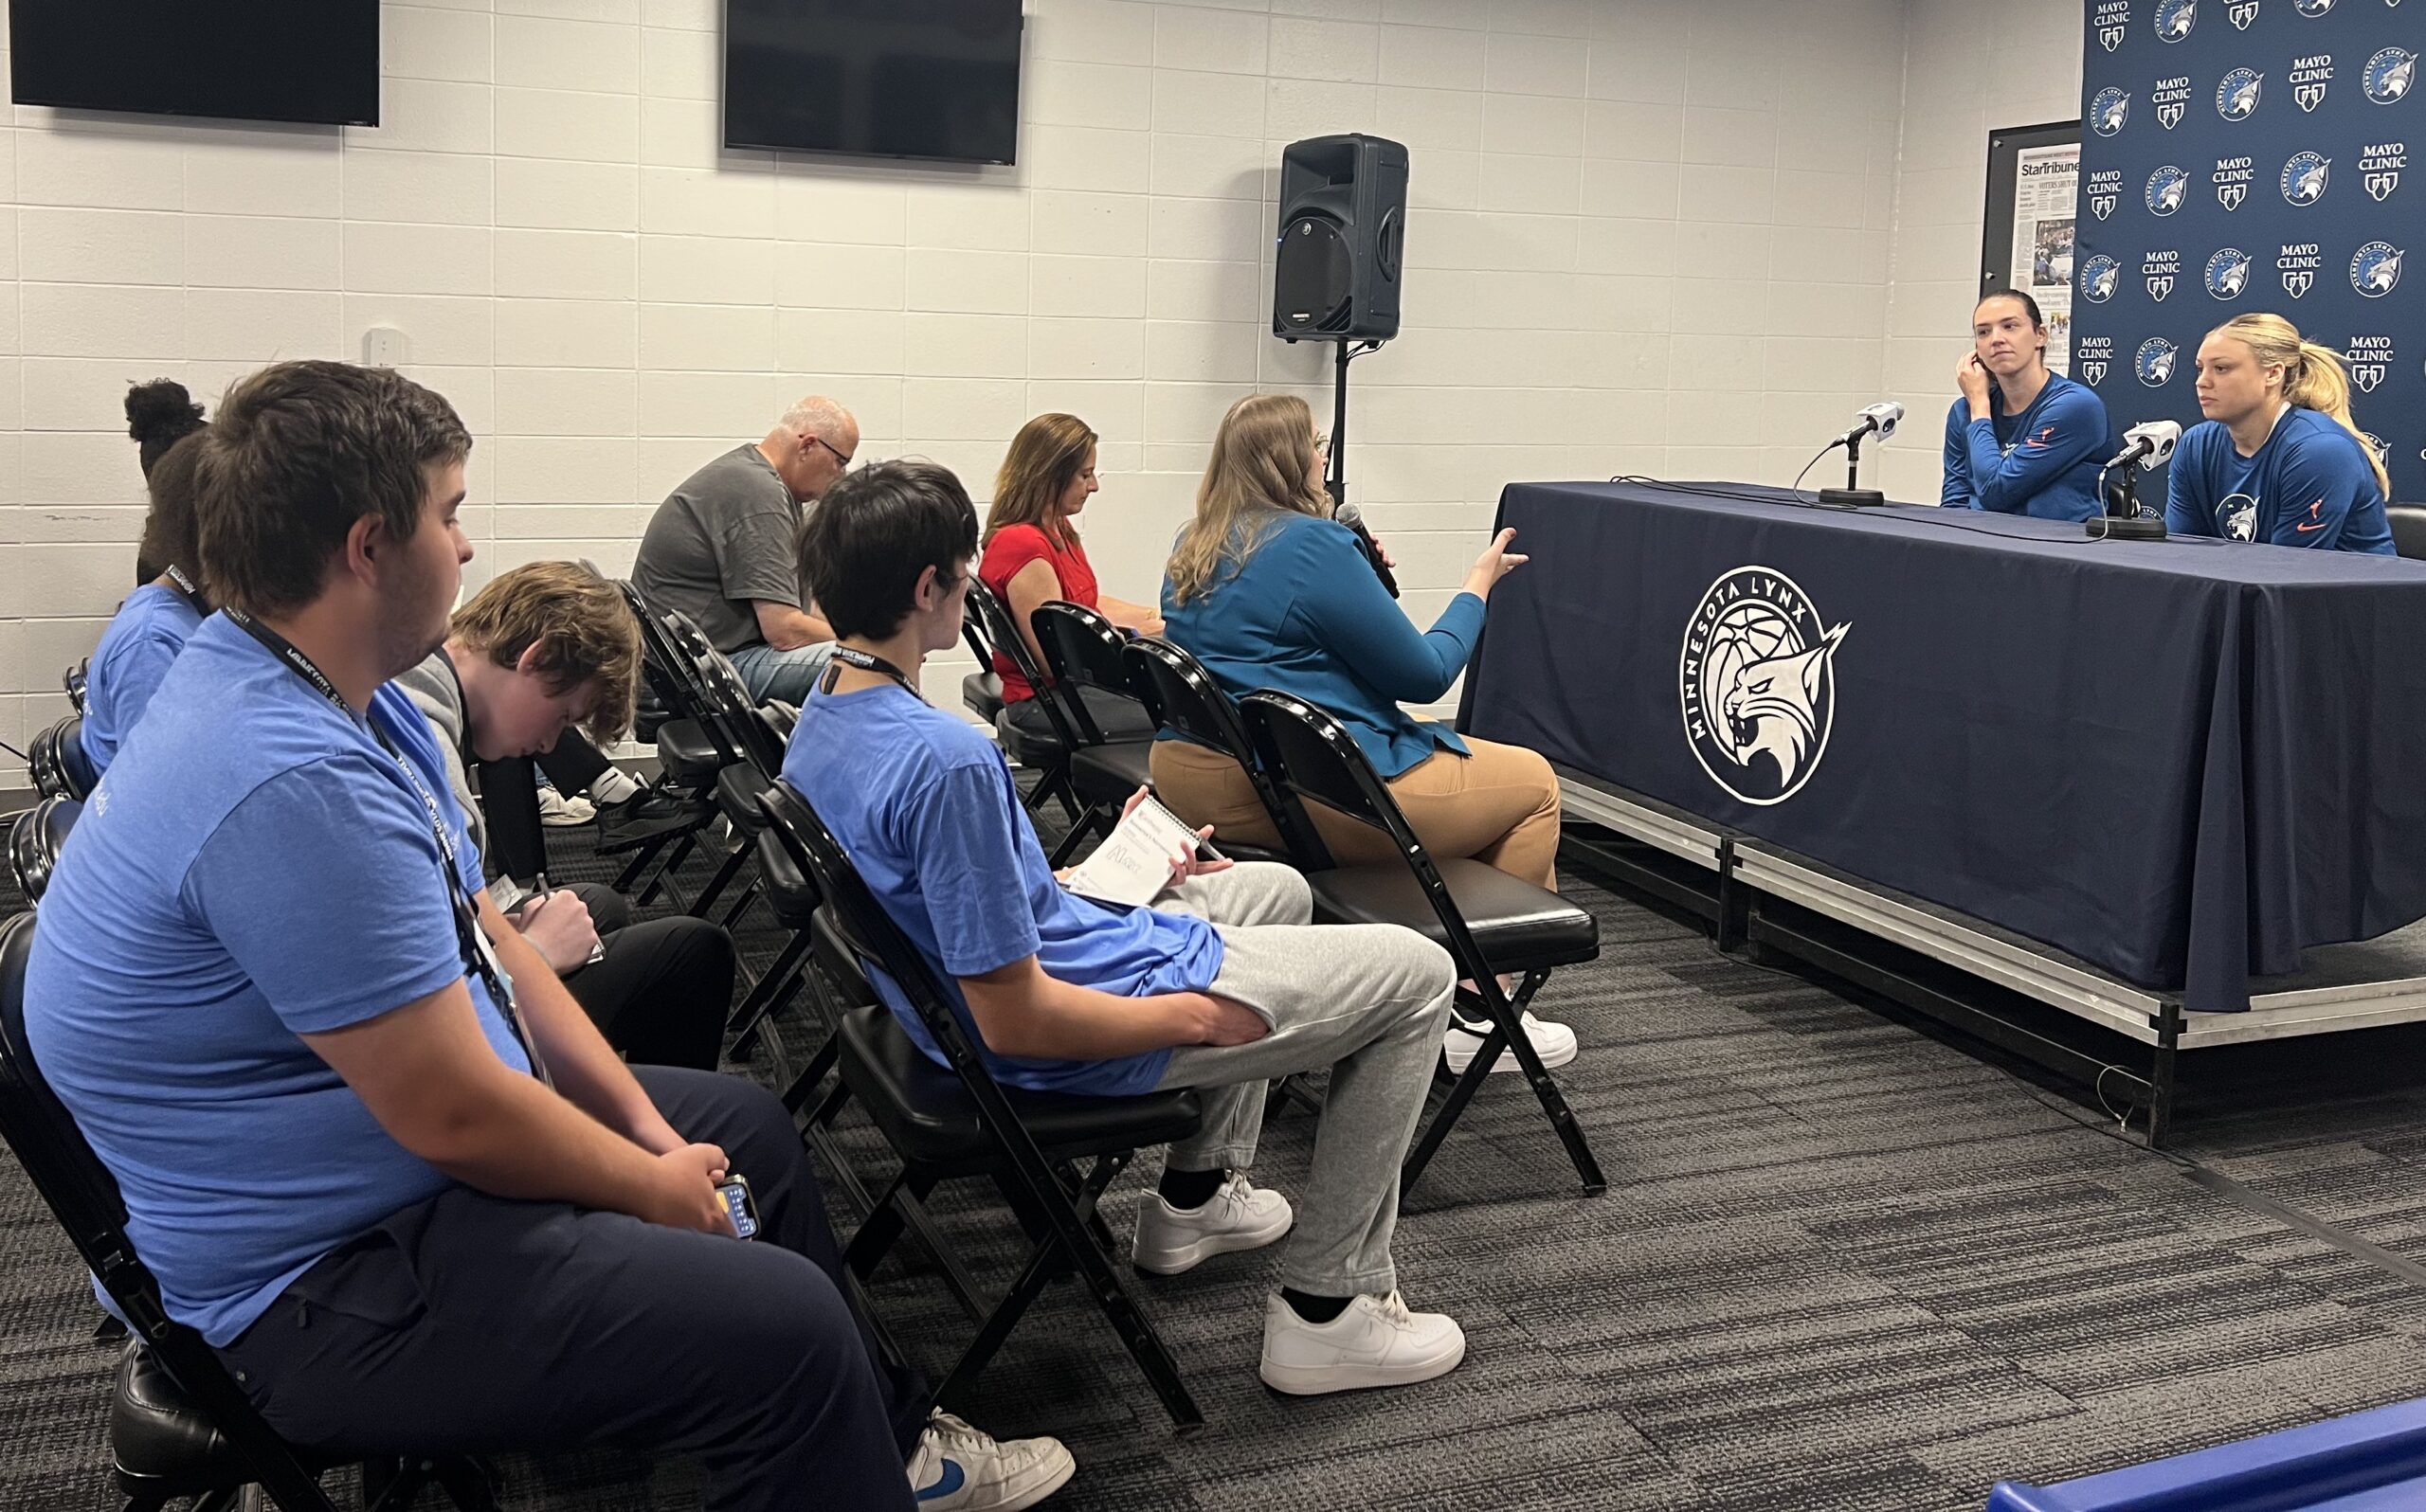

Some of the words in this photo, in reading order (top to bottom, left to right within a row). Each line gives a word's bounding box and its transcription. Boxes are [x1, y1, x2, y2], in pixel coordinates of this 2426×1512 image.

[2097, 1, 2128, 14] MAYO
[2093, 11, 2130, 26] CLINIC
[2293, 55, 2331, 69] MAYO
[2289, 68, 2334, 83] CLINIC
[2156, 77, 2189, 91] MAYO
[2152, 89, 2191, 103] CLINIC
[2363, 143, 2404, 157] MAYO
[2216, 157, 2252, 171] MAYO
[2358, 156, 2407, 171] CLINIC
[2091, 171, 2121, 183] MAYO
[2212, 169, 2254, 183] CLINIC
[2087, 181, 2123, 194] CLINIC
[2145, 250, 2179, 262] MAYO
[2281, 243, 2319, 257] MAYO
[2142, 261, 2181, 274] CLINIC
[2276, 256, 2321, 269] CLINIC
[2081, 337, 2111, 348] MAYO
[2350, 336, 2391, 350] MAYO
[2077, 348, 2113, 359] CLINIC
[2346, 349, 2394, 362] CLINIC
[1686, 581, 1740, 741] MINNESOTA
[1750, 576, 1807, 623] LYNX
